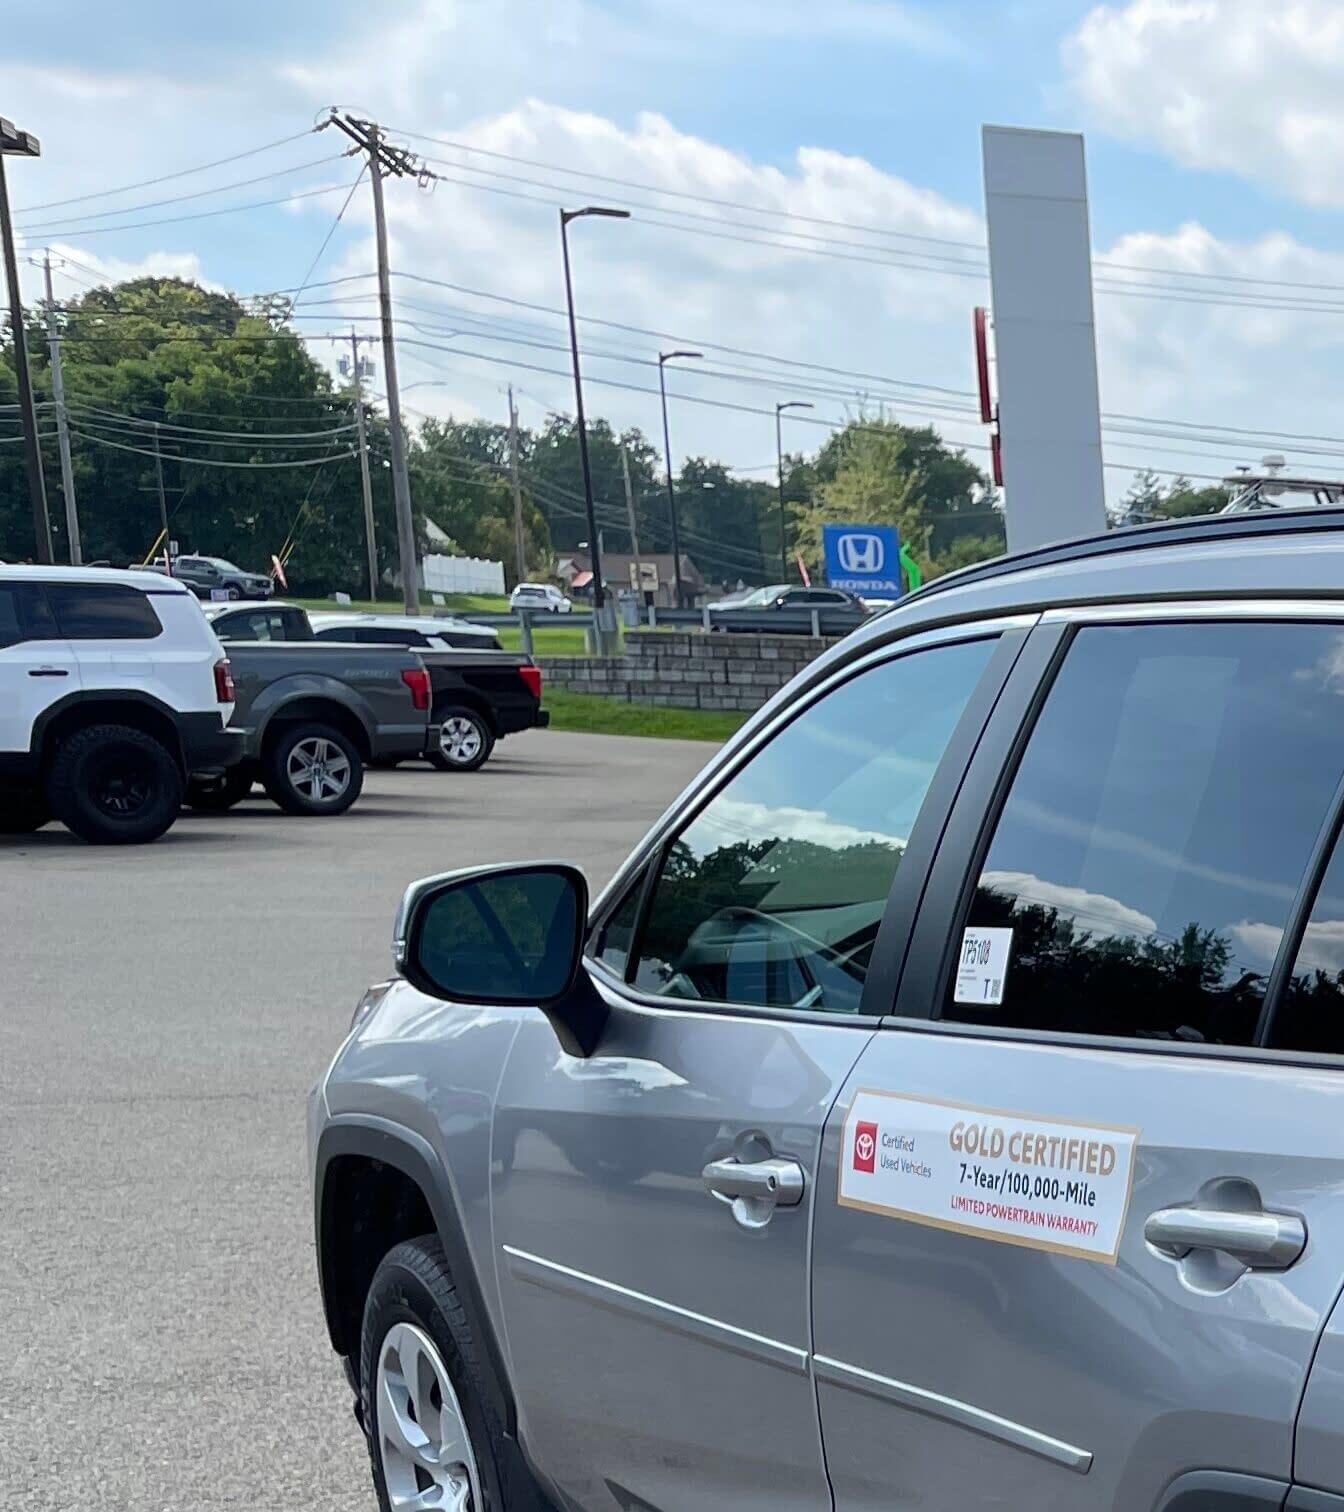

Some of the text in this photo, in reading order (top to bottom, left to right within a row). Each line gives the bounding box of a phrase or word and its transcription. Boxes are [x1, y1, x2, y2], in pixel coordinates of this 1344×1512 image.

[831, 579, 898, 591] HONDA
[881, 1132, 915, 1152] Certified
[949, 1120, 1117, 1177] GOLD CERTIFIED
[880, 1156, 932, 1179] Used Vehicles
[959, 1162, 1097, 1208] 7-Year/100,000-Mile
[951, 1194, 1099, 1237] LIMITED POWERTRAIN WARRANTY
